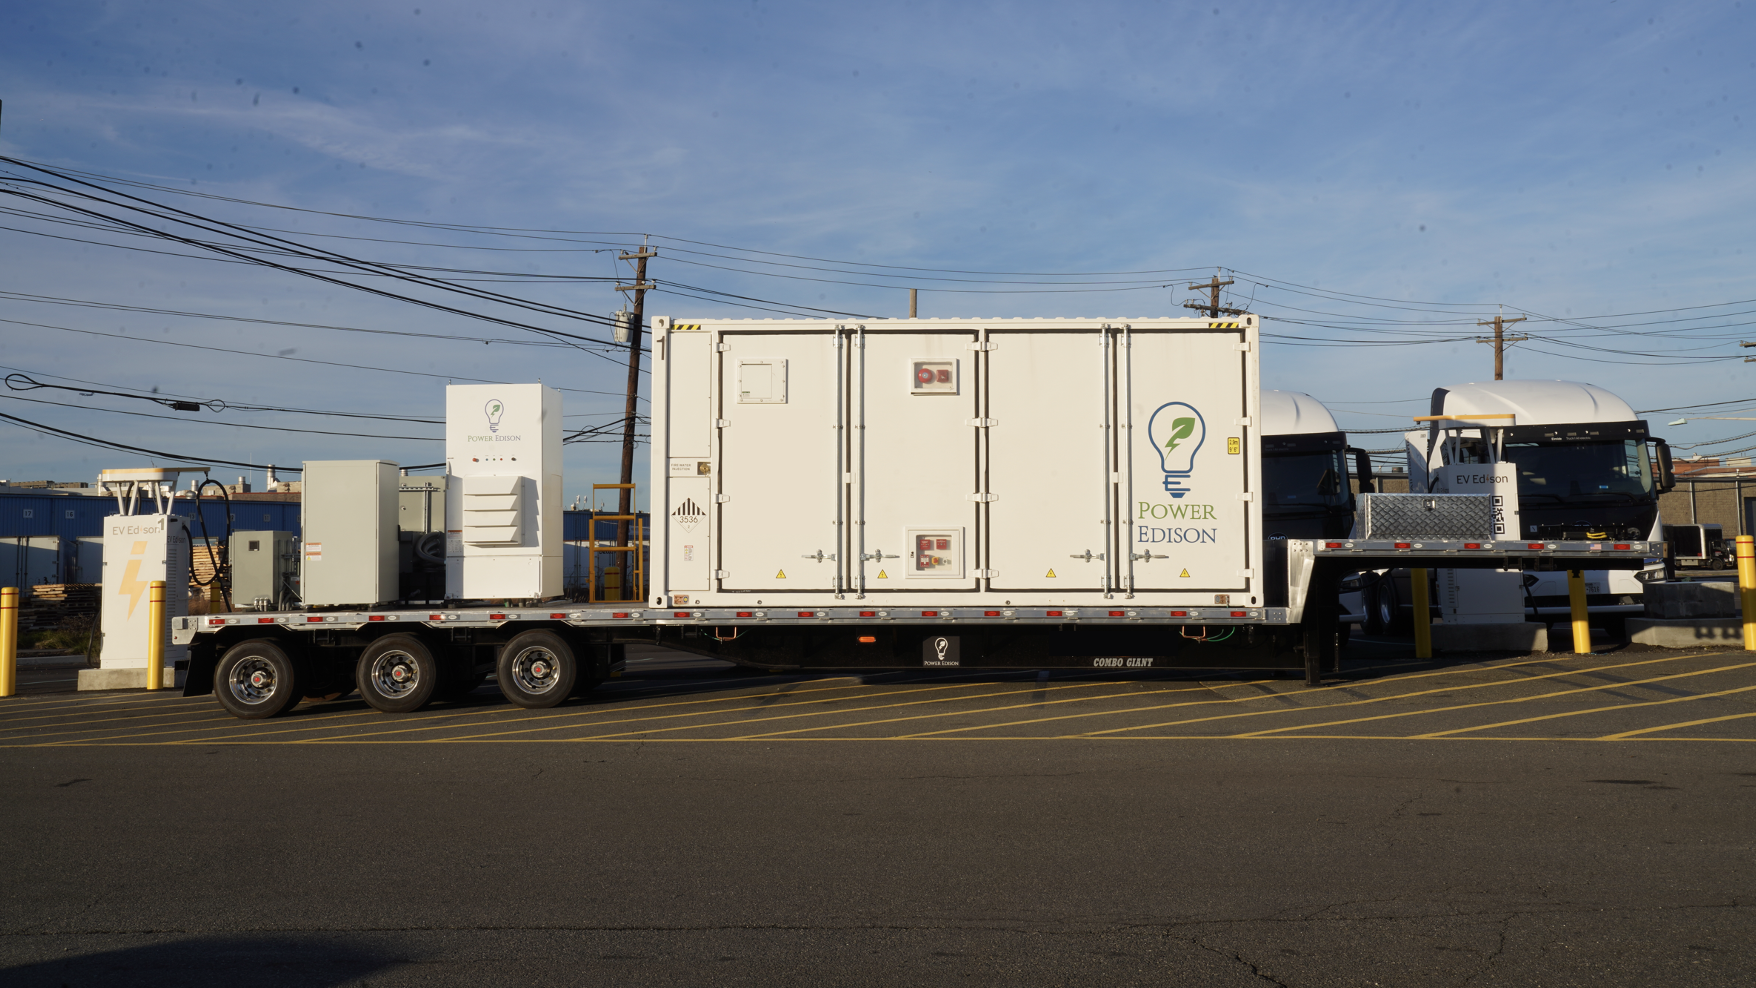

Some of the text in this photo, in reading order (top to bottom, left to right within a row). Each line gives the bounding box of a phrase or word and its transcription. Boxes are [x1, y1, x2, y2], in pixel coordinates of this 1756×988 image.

[1457, 475, 1470, 484] EV
[1138, 502, 1217, 520] POWER
[158, 518, 164, 530] 1
[113, 526, 125, 535] EV
[1138, 526, 1217, 543] EDISON
[1093, 658, 1153, 666] COMBO GIANT
